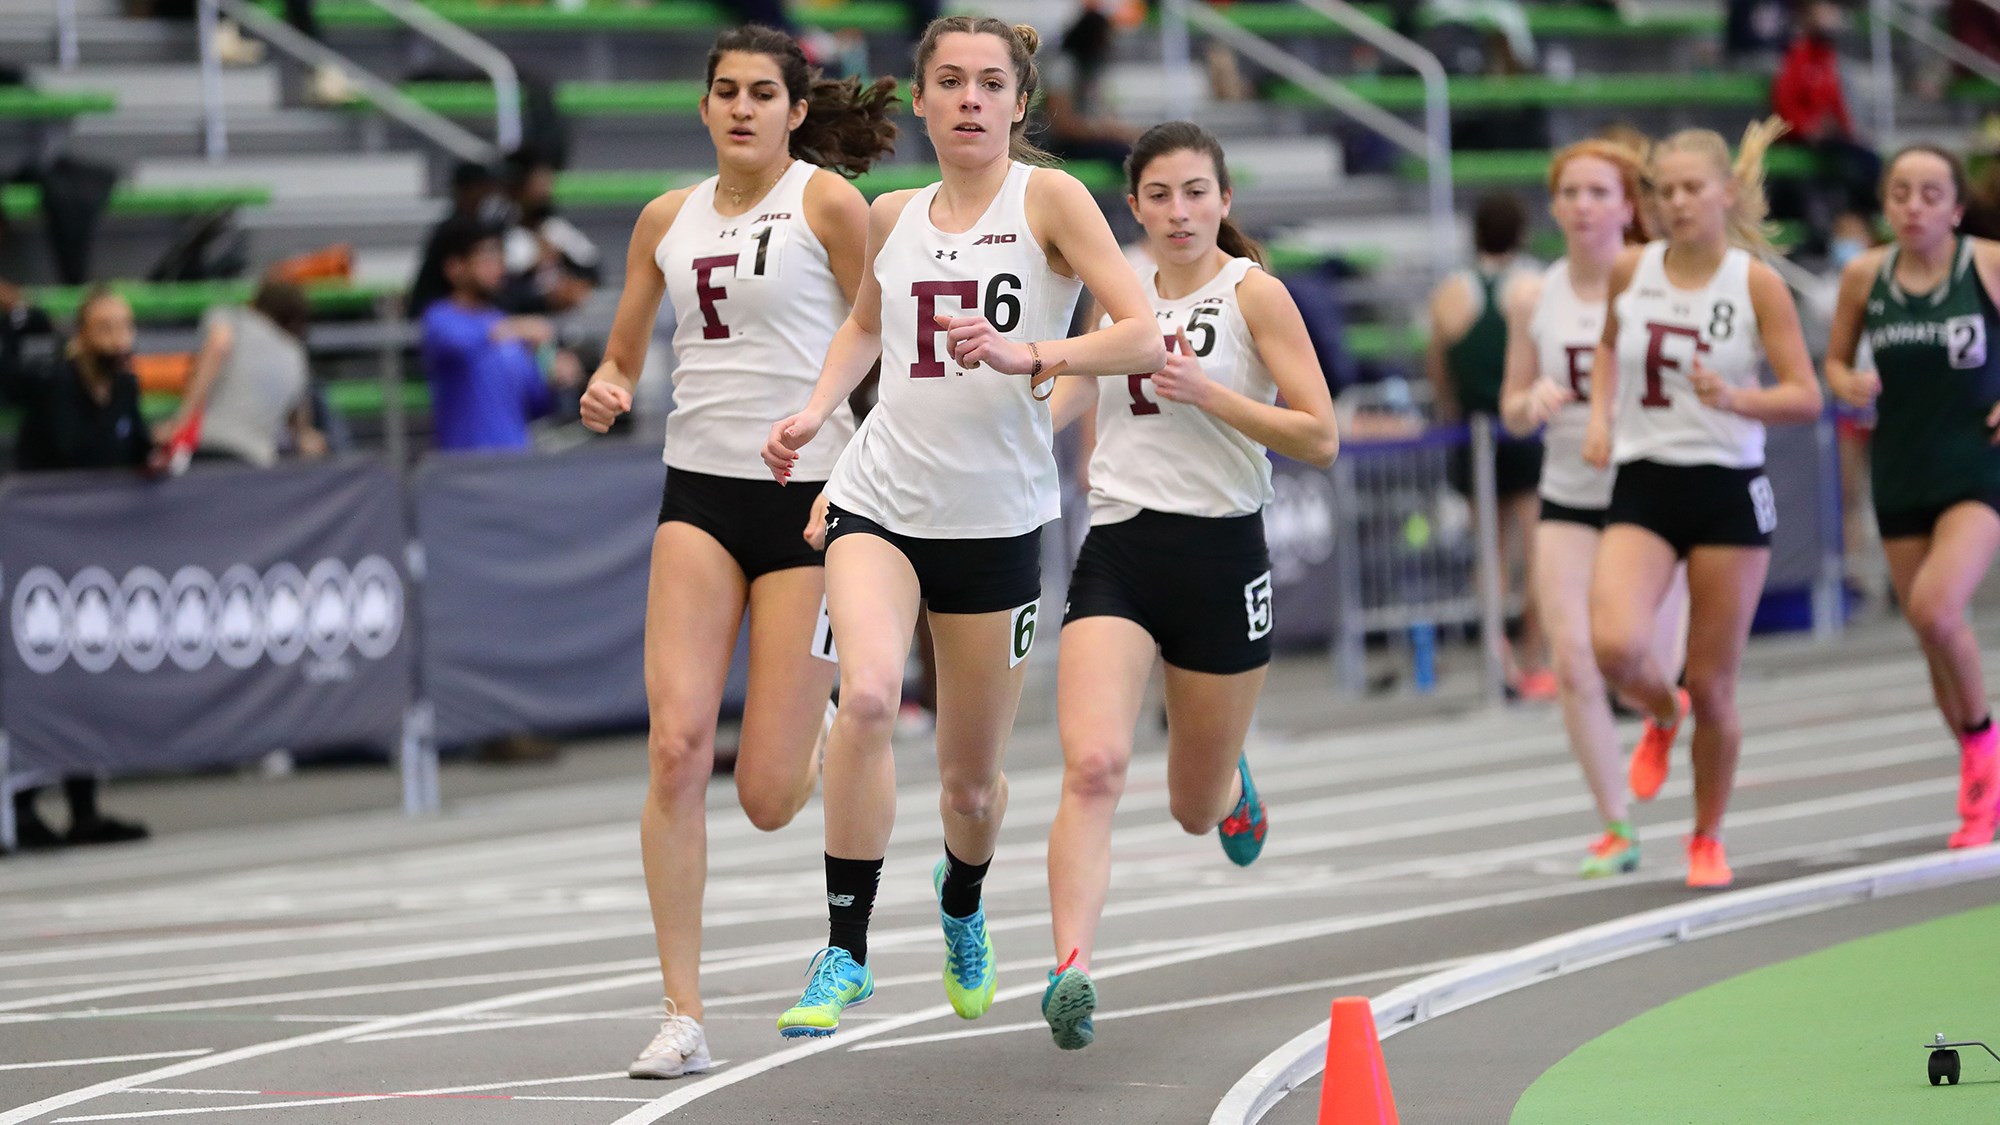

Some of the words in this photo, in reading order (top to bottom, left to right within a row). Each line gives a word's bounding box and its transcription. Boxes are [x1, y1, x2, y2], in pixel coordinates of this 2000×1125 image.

[750, 226, 773, 276] 1
[692, 254, 739, 340] F
[984, 272, 1022, 333] 6
[1708, 301, 1735, 339] 8
[909, 280, 979, 379] F
[1186, 307, 1220, 358] 5
[1952, 324, 1980, 366] 2
[1640, 321, 1712, 409] F
[1014, 603, 1037, 659] 6
[1251, 579, 1270, 633] 5
